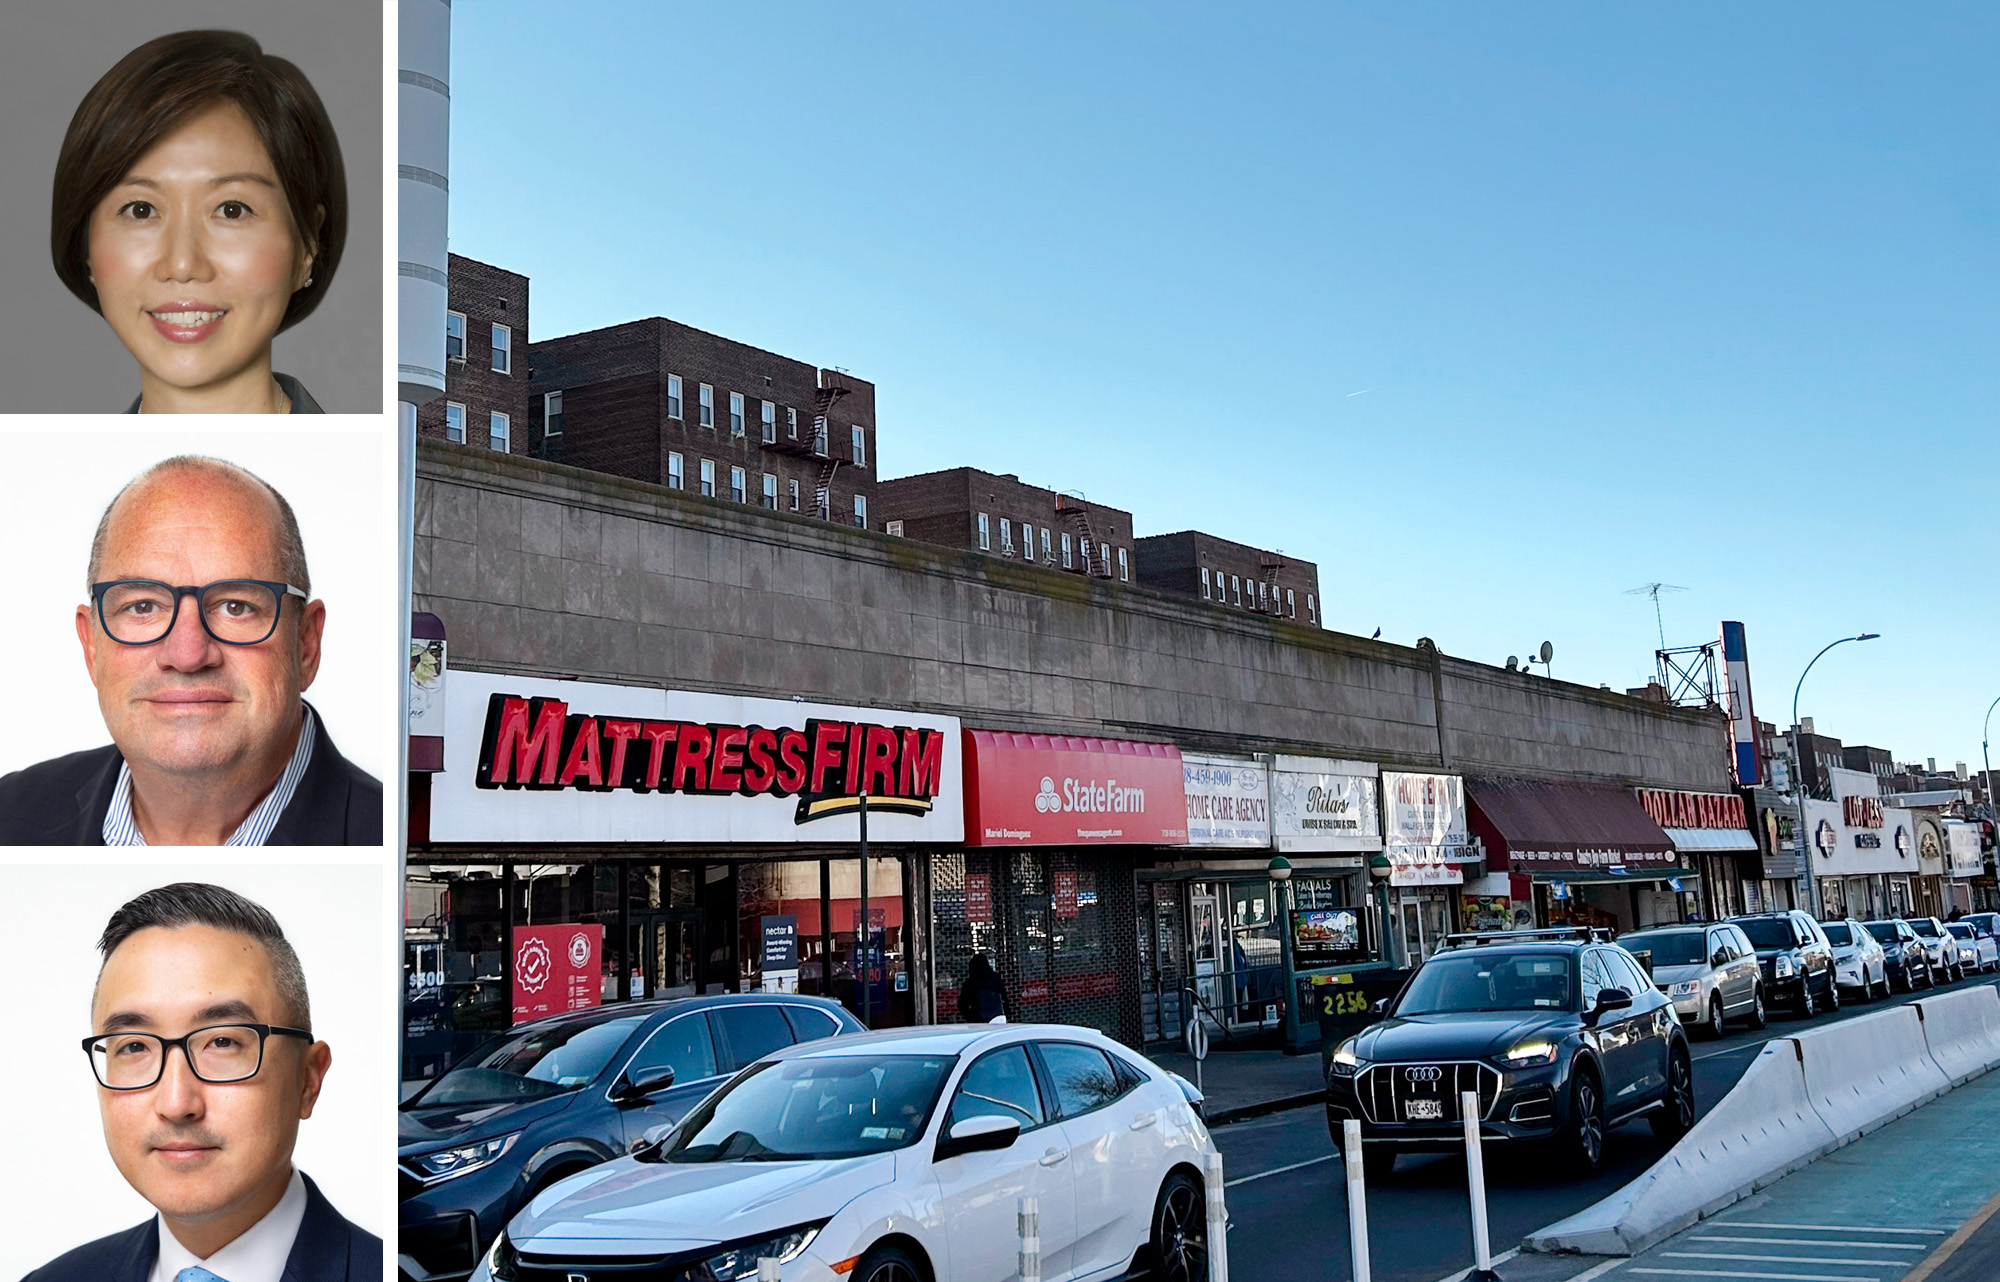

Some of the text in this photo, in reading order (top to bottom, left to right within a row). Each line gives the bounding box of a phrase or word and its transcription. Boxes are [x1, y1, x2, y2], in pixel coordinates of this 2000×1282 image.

[1185, 794, 1266, 822] HOME CARE AGENCY
[1642, 790, 1696, 828] DOLLAR
[1697, 795, 1748, 829] BAZAAR
[1296, 879, 1332, 892] FACIALS
[765, 925, 787, 936] nectar
[1323, 991, 1368, 1015] 2256
